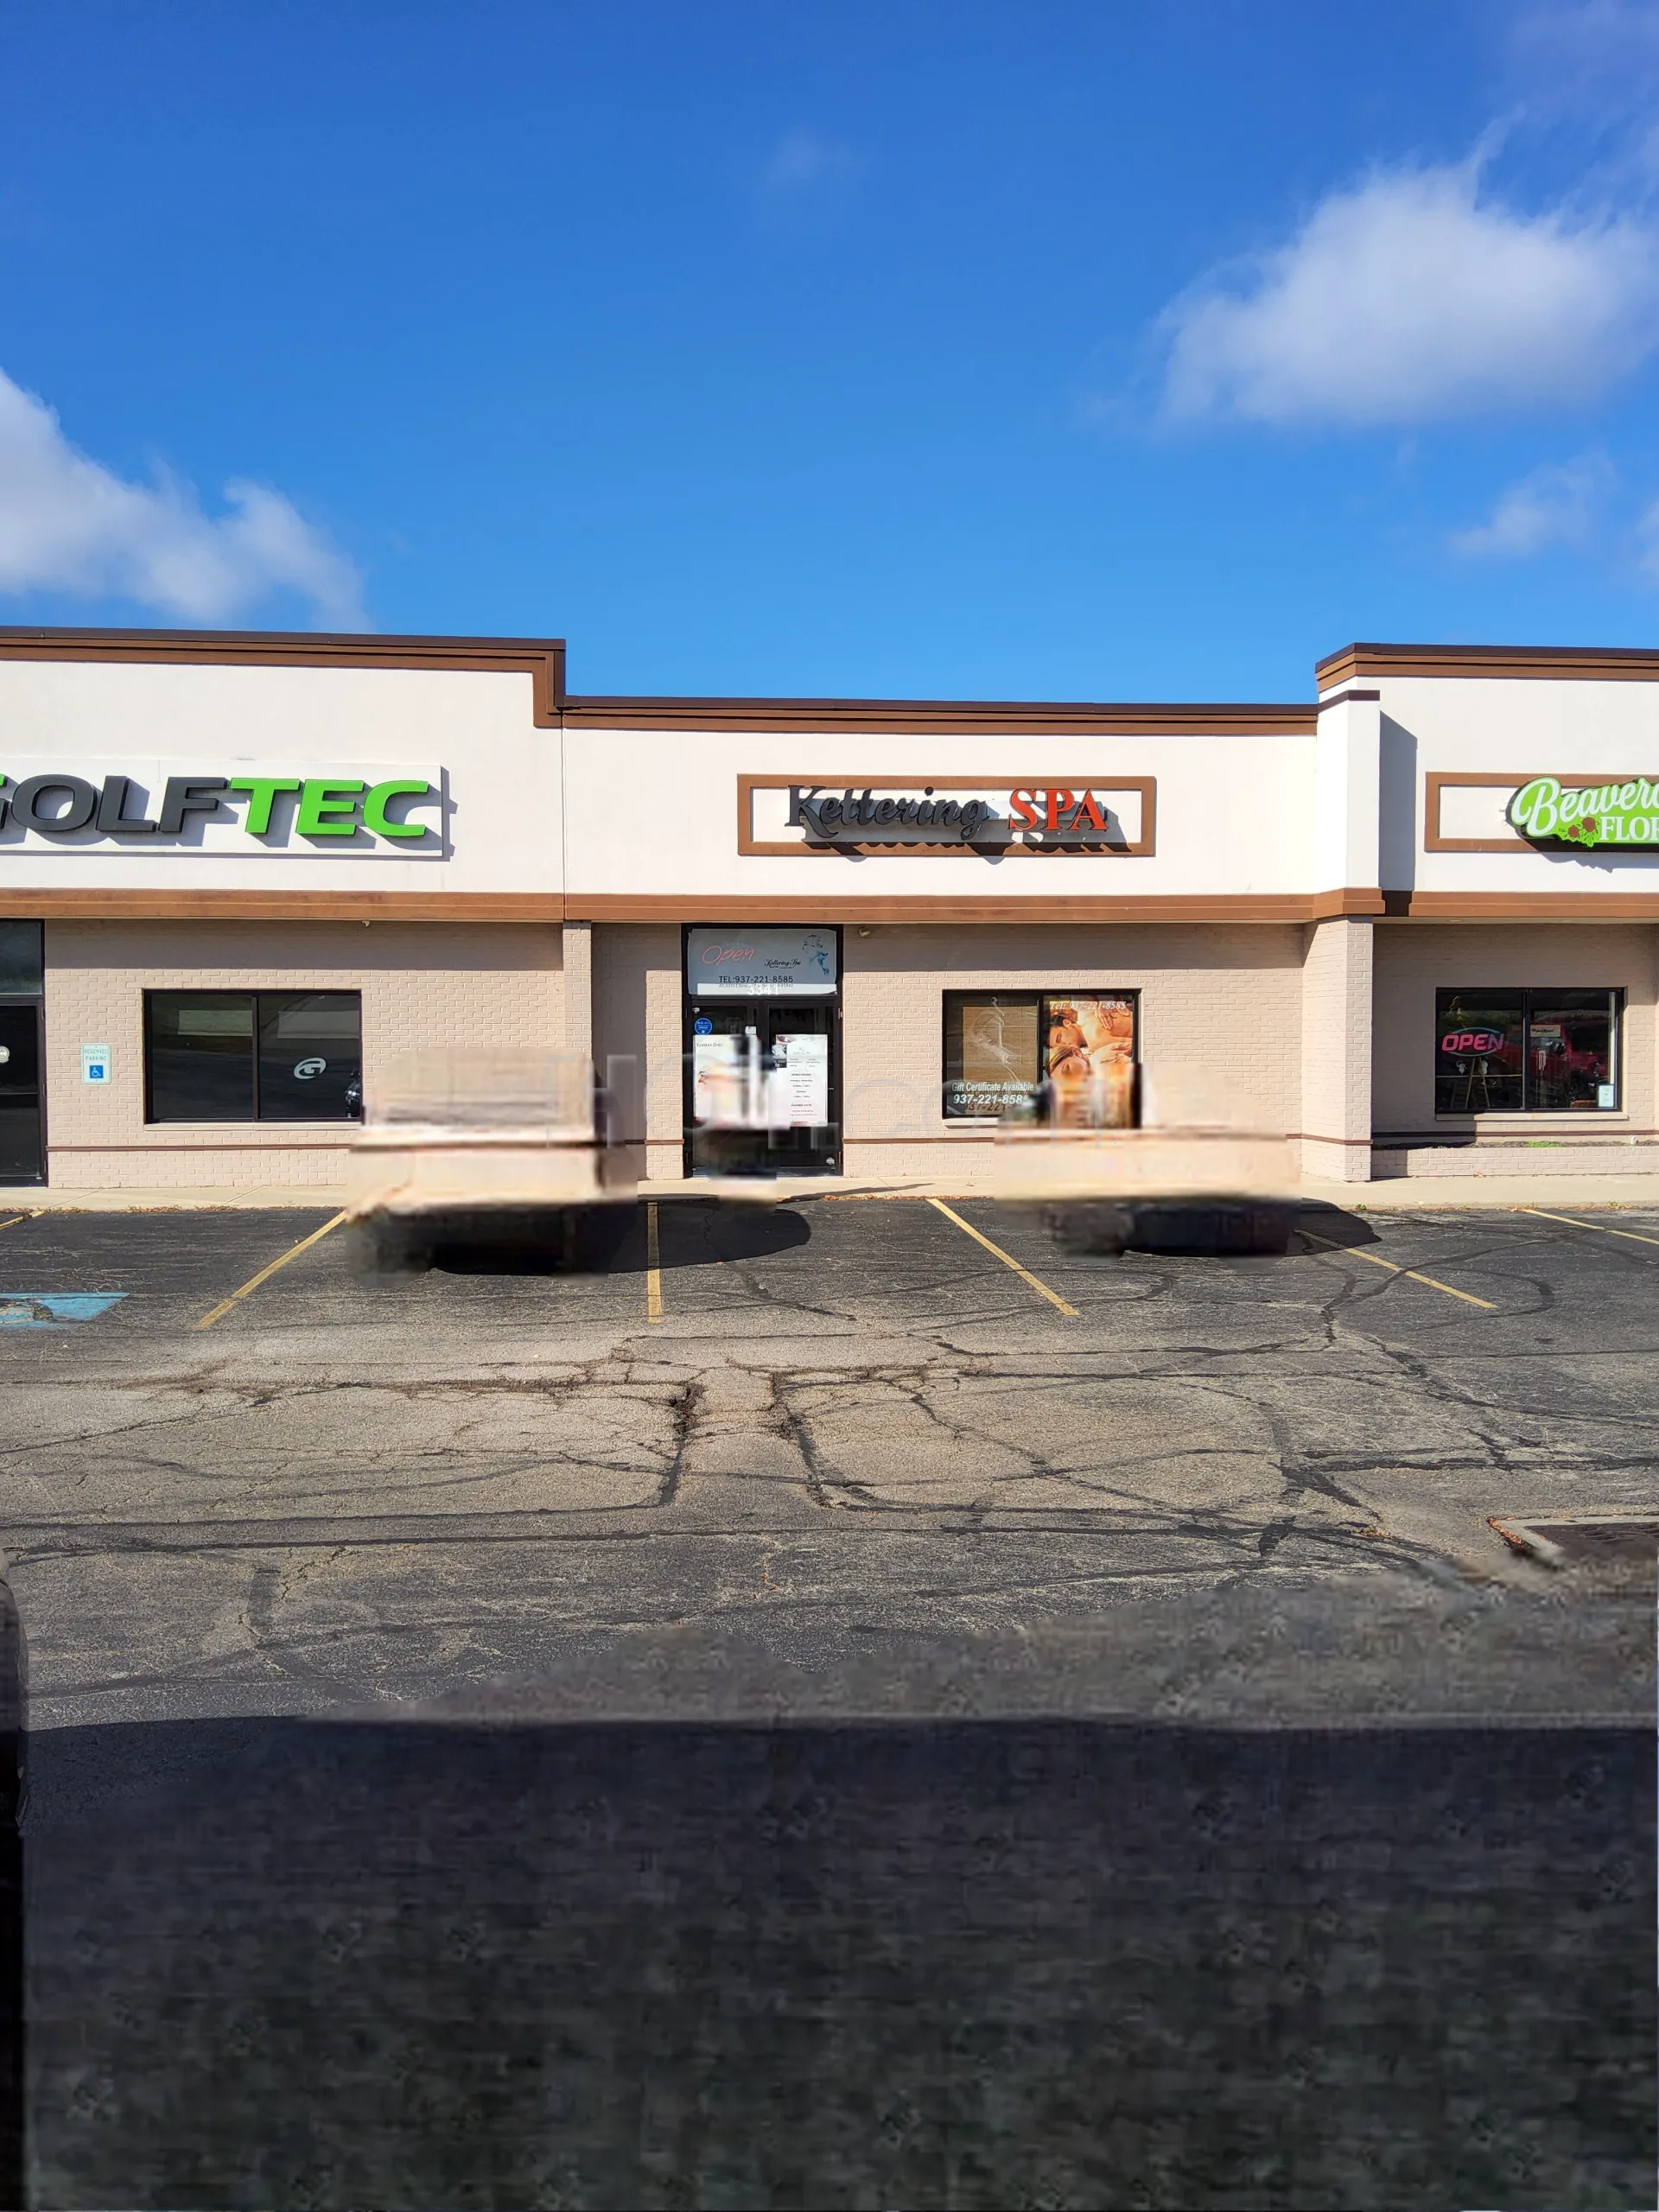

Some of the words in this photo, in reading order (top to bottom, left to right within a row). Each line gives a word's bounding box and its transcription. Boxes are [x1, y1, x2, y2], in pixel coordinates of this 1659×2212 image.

[0, 774, 429, 837] OLFTEC
[785, 785, 990, 841] Kettering
[1007, 787, 1110, 833] SPA
[702, 944, 754, 966] Open
[1049, 1001, 1068, 1010] Tel:
[1069, 1001, 1128, 1010] 937-221-8585
[1441, 1033, 1504, 1052] OPEN
[951, 1082, 965, 1092] Gift
[966, 1082, 1001, 1092] Certificate
[1001, 1082, 1034, 1092] Available
